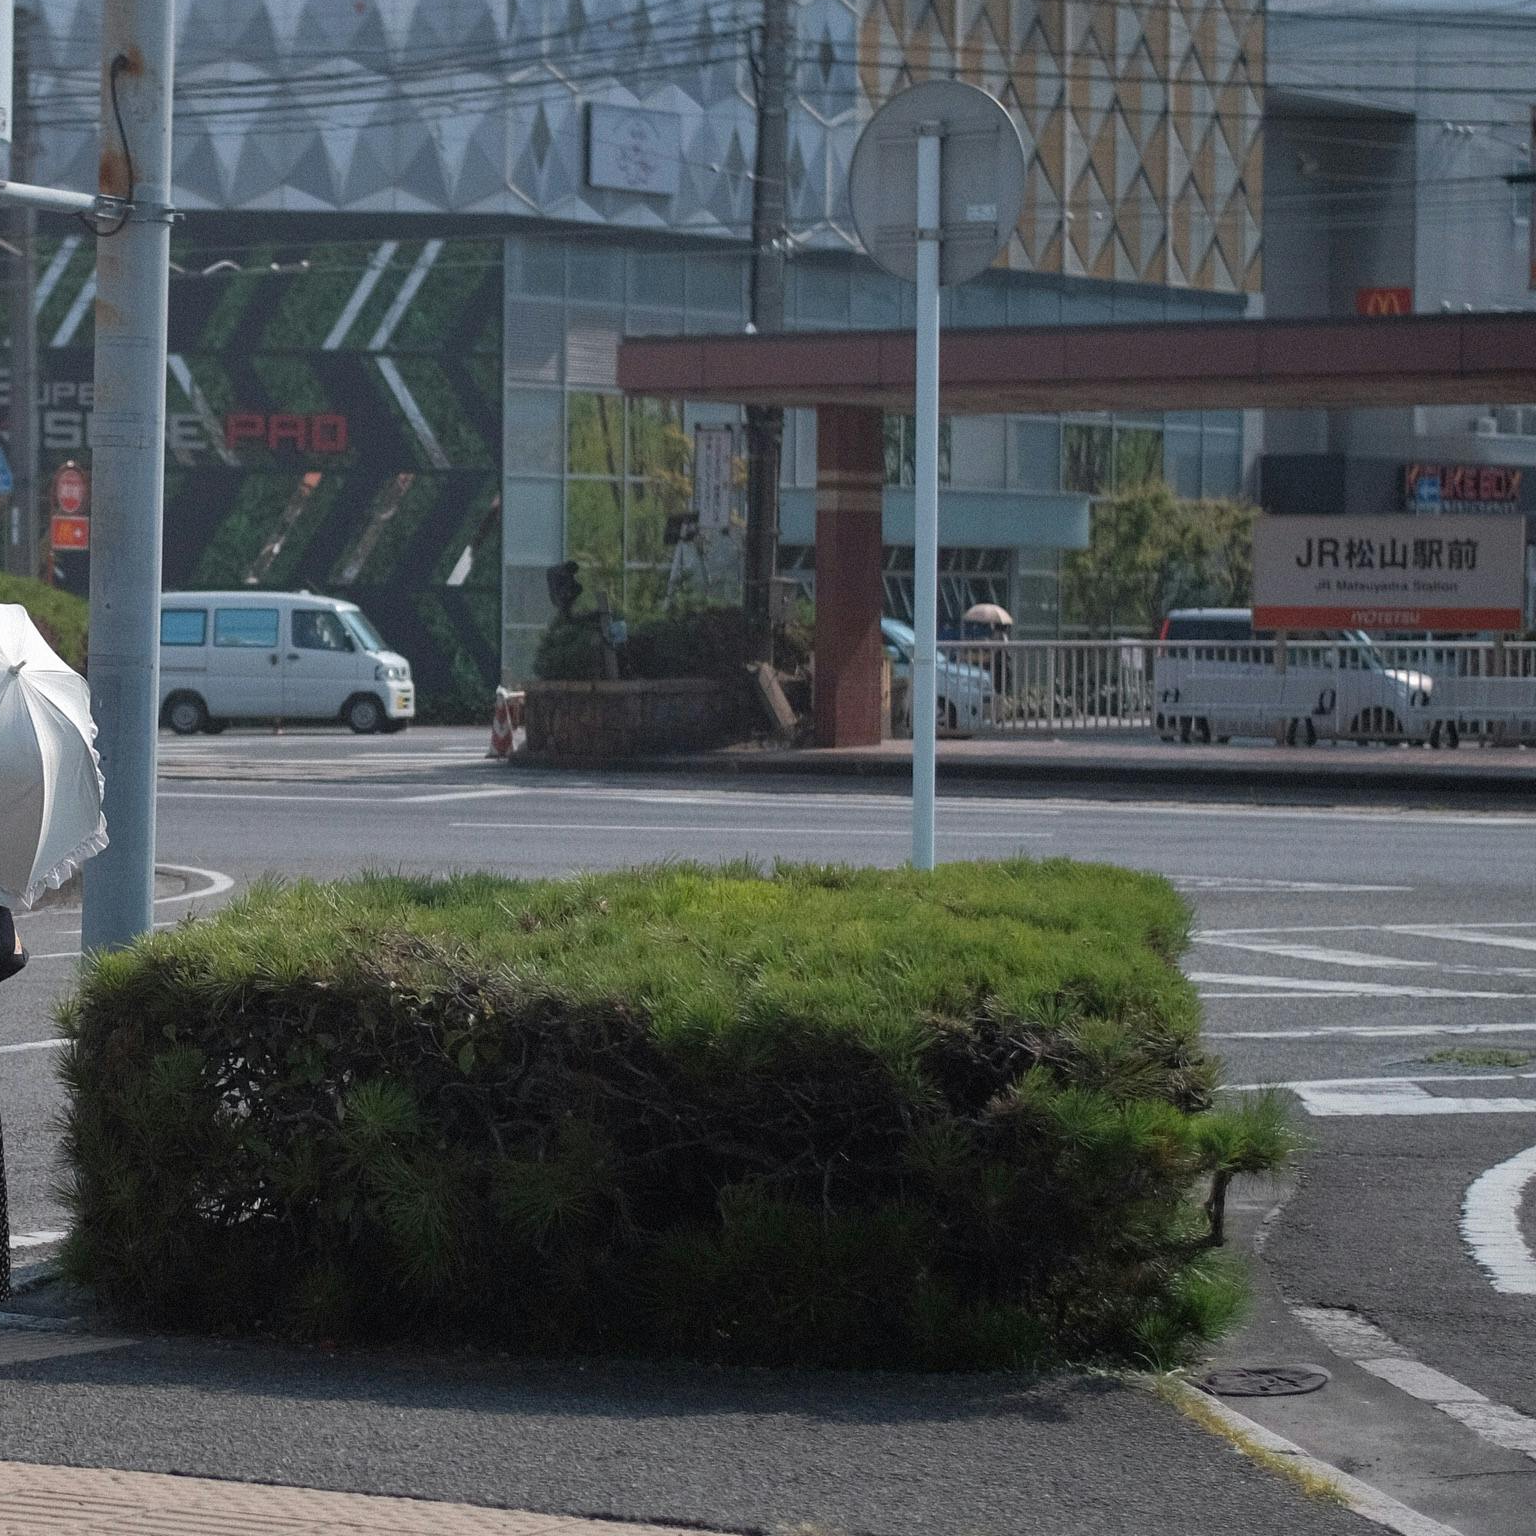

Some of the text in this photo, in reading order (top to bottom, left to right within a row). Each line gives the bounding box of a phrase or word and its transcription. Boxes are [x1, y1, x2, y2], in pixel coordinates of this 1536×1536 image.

[1296, 537, 1478, 570] JR松山駅前
[1336, 579, 1408, 594] Matsuyama
[1414, 579, 1459, 592] Station
